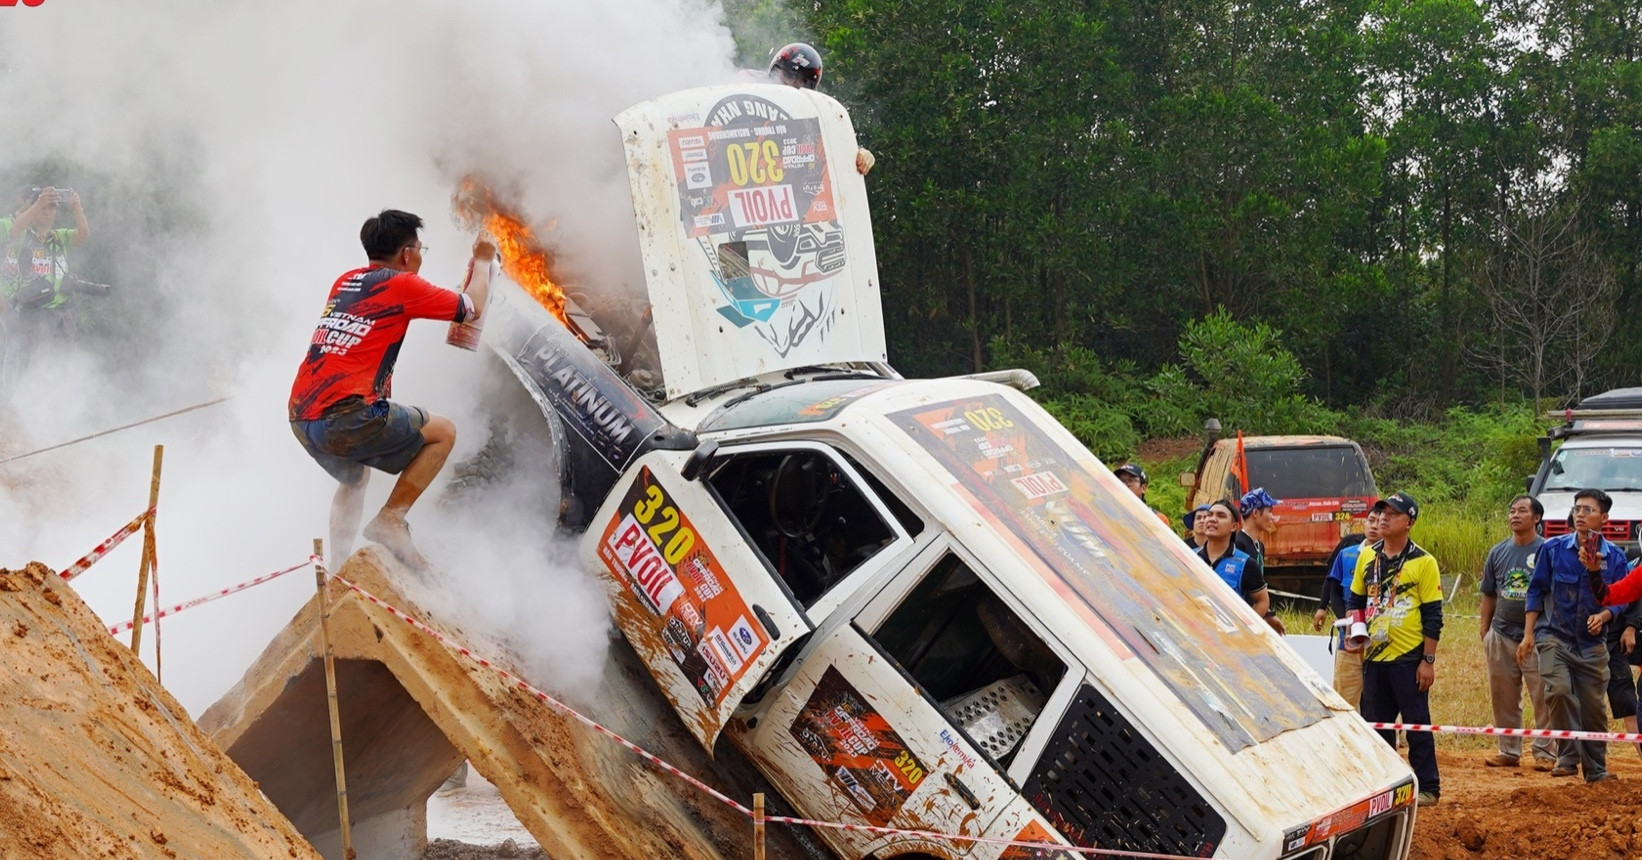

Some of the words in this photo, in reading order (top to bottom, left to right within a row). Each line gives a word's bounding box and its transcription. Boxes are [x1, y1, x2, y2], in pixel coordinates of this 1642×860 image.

[726, 140, 784, 187] 320
[734, 187, 793, 224] PVOIL
[326, 330, 362, 349] CUP
[534, 344, 635, 444] PLATINUM
[964, 407, 1014, 432] 320
[1016, 473, 1063, 497] PVOIL
[634, 484, 695, 565] 320
[609, 523, 673, 608] PVOIL
[701, 645, 726, 680] ISUZU
[847, 734, 869, 756] CUP
[894, 749, 924, 785] 320
[1371, 793, 1390, 815] PVOIL
[1394, 783, 1412, 805] 320
